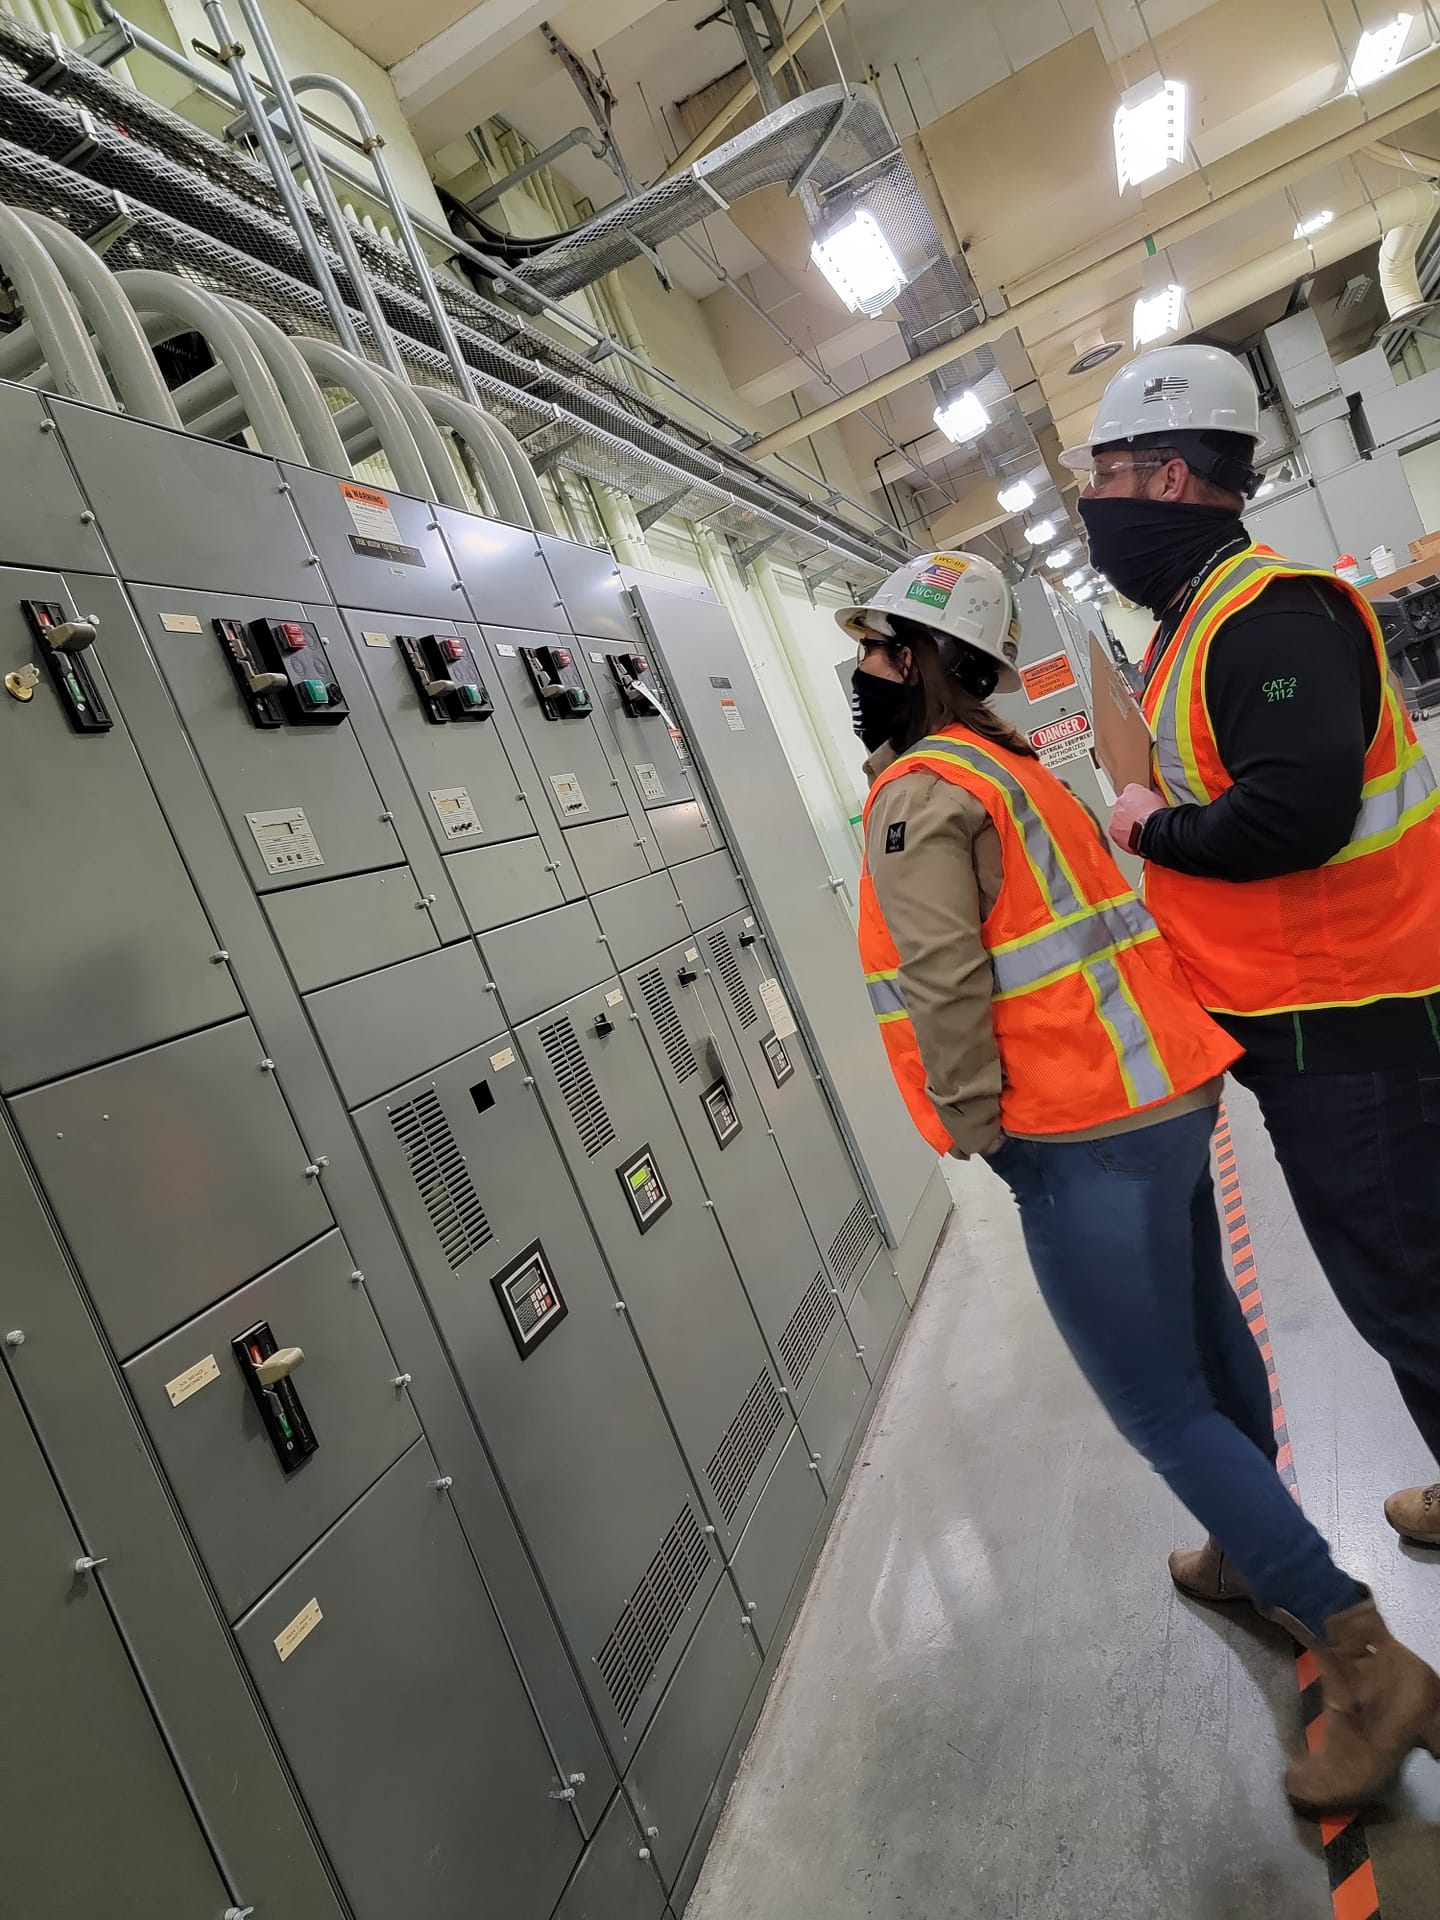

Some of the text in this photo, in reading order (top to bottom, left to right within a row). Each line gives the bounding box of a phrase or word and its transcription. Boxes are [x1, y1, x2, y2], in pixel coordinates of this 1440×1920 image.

[909, 585, 947, 603] LWC-08
[1262, 677, 1297, 692] CAT-2
[1267, 688, 1294, 703] 2112
[1037, 718, 1081, 746] DANGER
[1064, 731, 1094, 746] EQUIPMENT
[1048, 742, 1086, 760] AUTHORIZED
